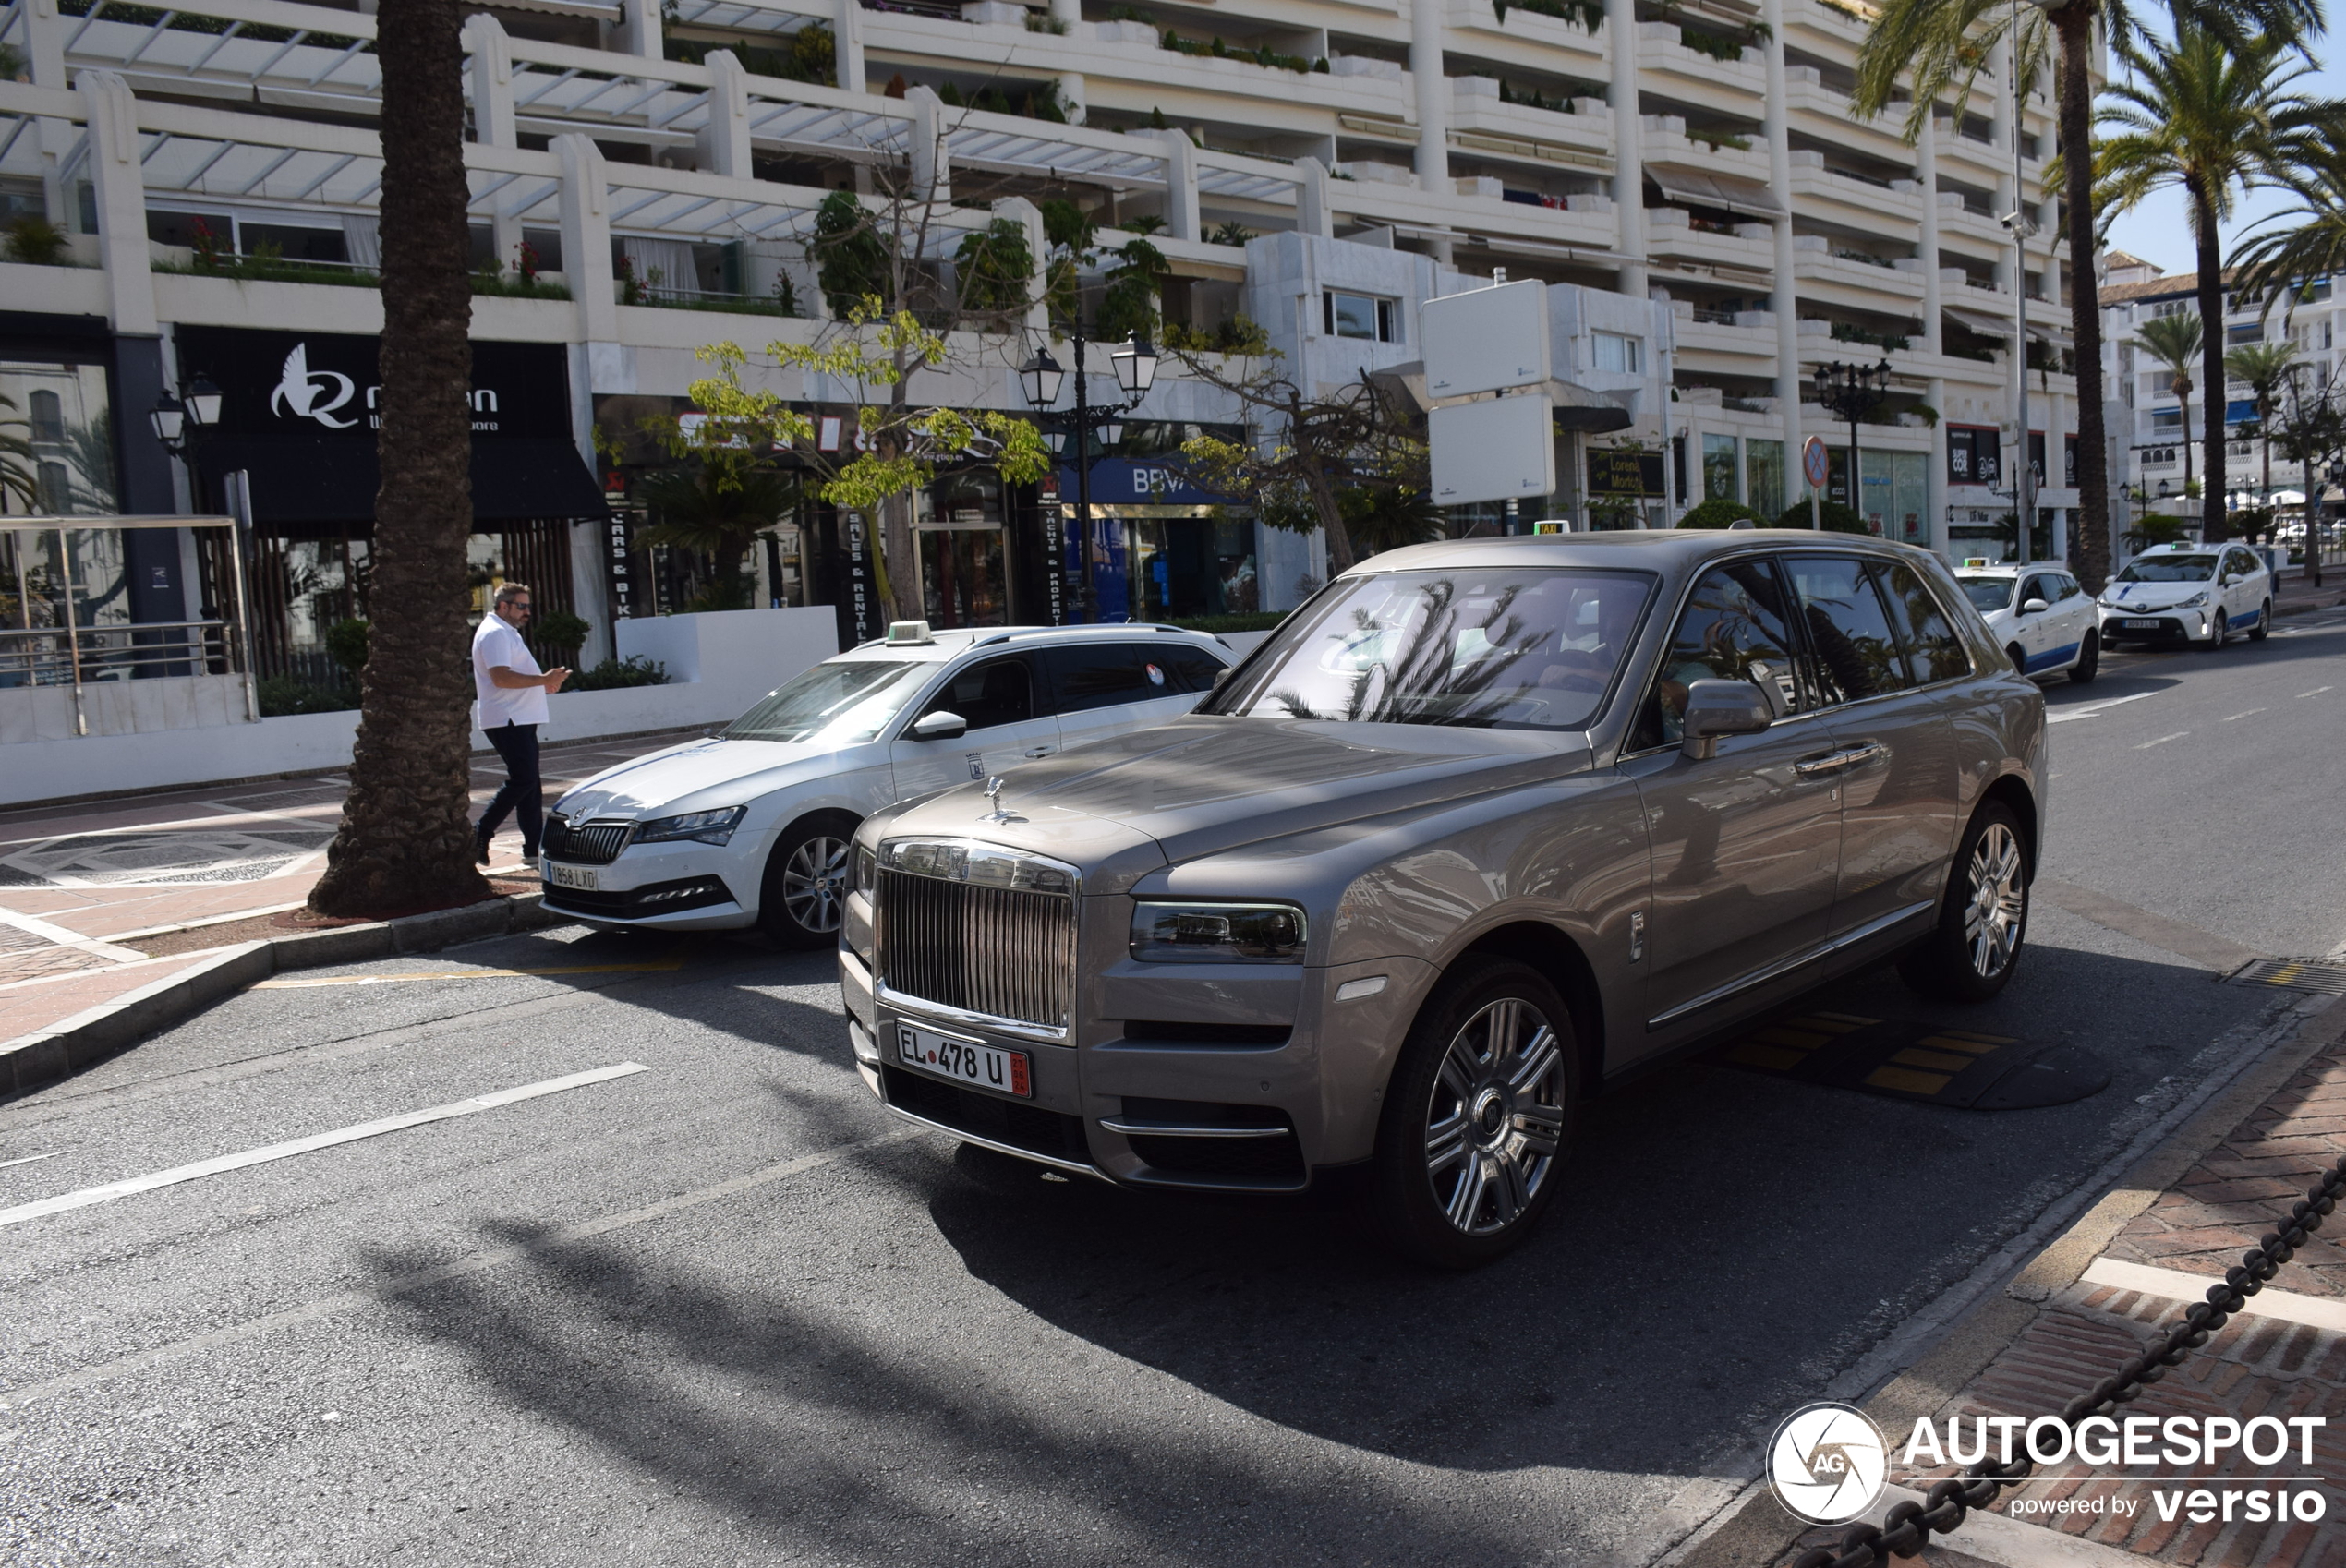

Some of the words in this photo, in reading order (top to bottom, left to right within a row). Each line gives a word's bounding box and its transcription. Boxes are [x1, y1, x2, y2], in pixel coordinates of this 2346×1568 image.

[849, 513, 863, 561] SALES
[1046, 510, 1058, 551] YACHTS
[1540, 524, 1557, 534] TAXI
[853, 568, 864, 577] &
[615, 583, 631, 621] BIK
[553, 866, 574, 885] 1858
[575, 869, 595, 888] LXD
[900, 1028, 926, 1065] EL
[938, 1042, 978, 1079] 478
[986, 1052, 1004, 1085] U
[1012, 1058, 1022, 1068] 27
[1015, 1080, 1025, 1091] 24
